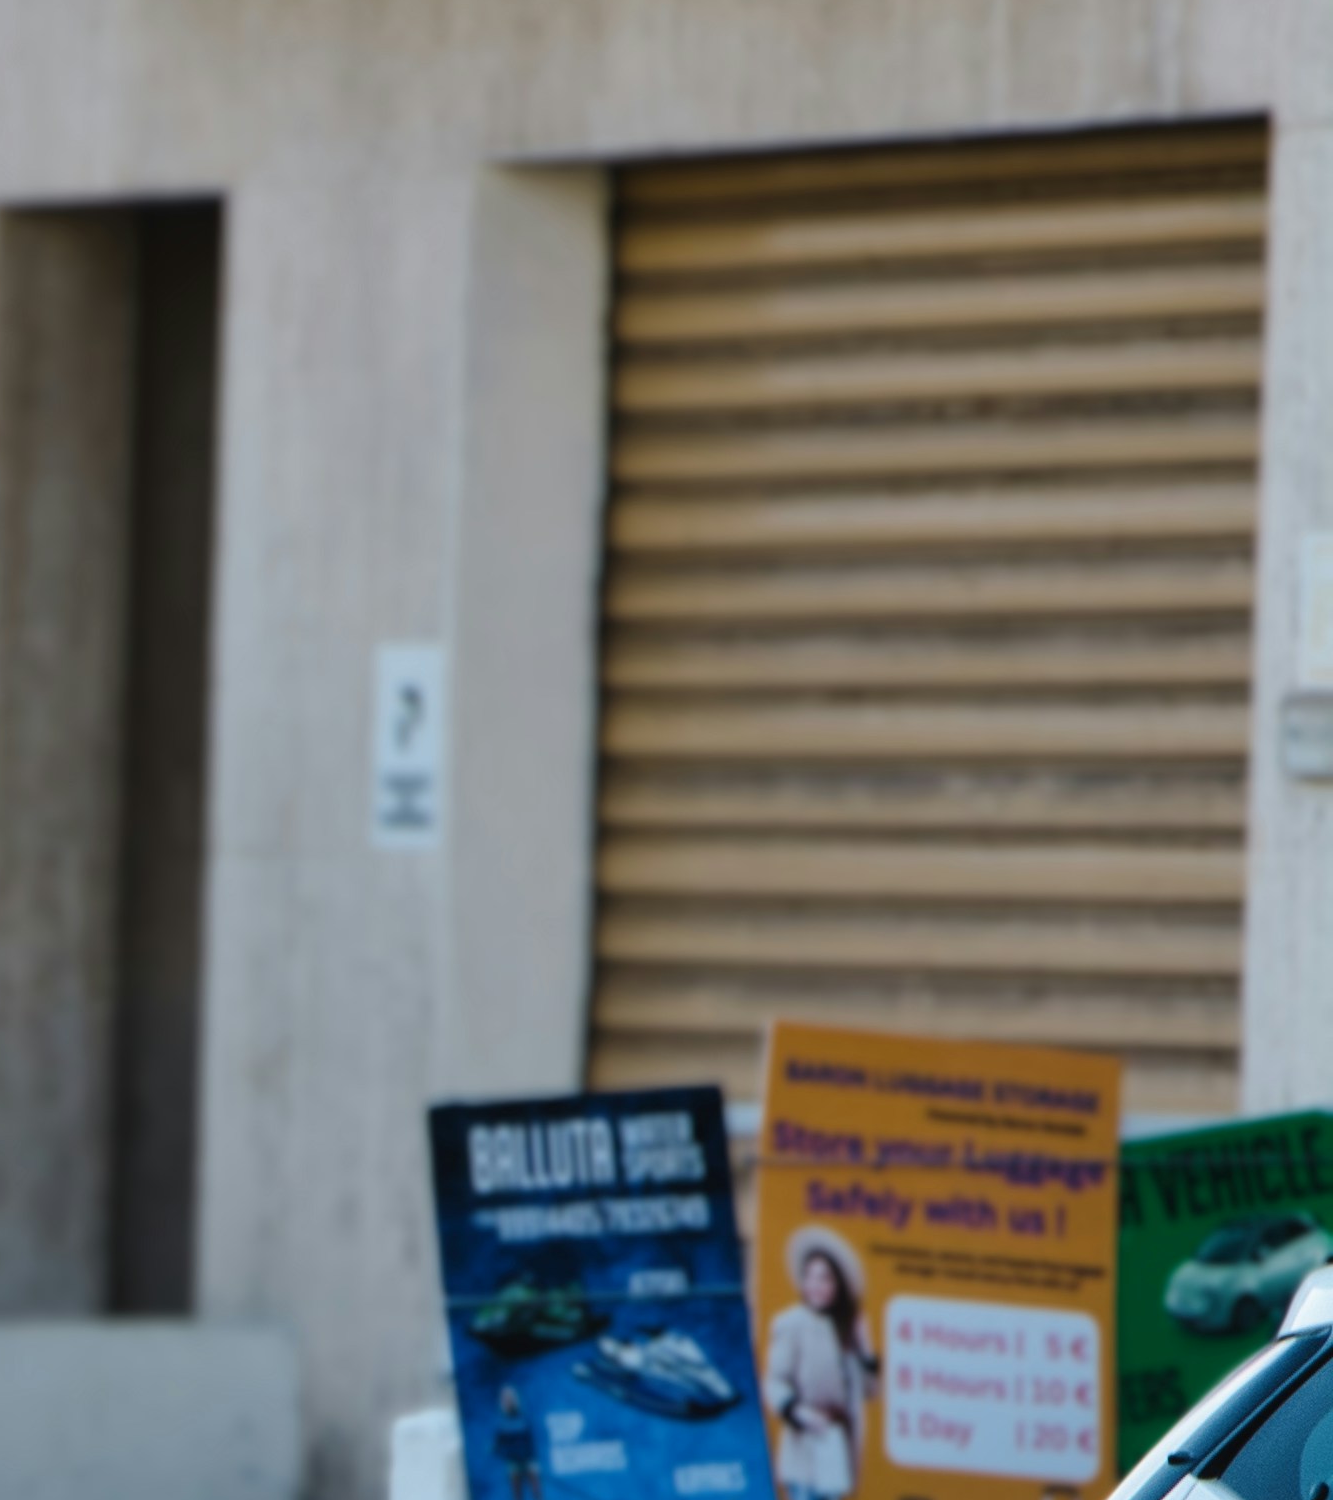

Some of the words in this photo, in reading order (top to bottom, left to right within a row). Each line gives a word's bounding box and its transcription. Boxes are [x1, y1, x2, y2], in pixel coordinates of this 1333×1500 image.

[877, 1073, 983, 1100] LUGGAGE
[993, 1081, 1100, 1114] STORAGE
[620, 1110, 693, 1149] WATER
[469, 1116, 617, 1194] BALLUTA
[623, 1141, 706, 1183] SPORTS
[774, 1120, 862, 1162] Store
[875, 1137, 951, 1173] your
[962, 1138, 1107, 1192] Luggage
[806, 1179, 912, 1231] Safely
[925, 1194, 998, 1231] with
[1008, 1207, 1045, 1236] us
[922, 1323, 1008, 1355] Hours
[921, 1369, 1007, 1400] Hours
[1033, 1376, 1067, 1407] 10
[545, 1411, 583, 1442] SUP
[918, 1411, 974, 1450] Day
[1033, 1420, 1067, 1452] 20
